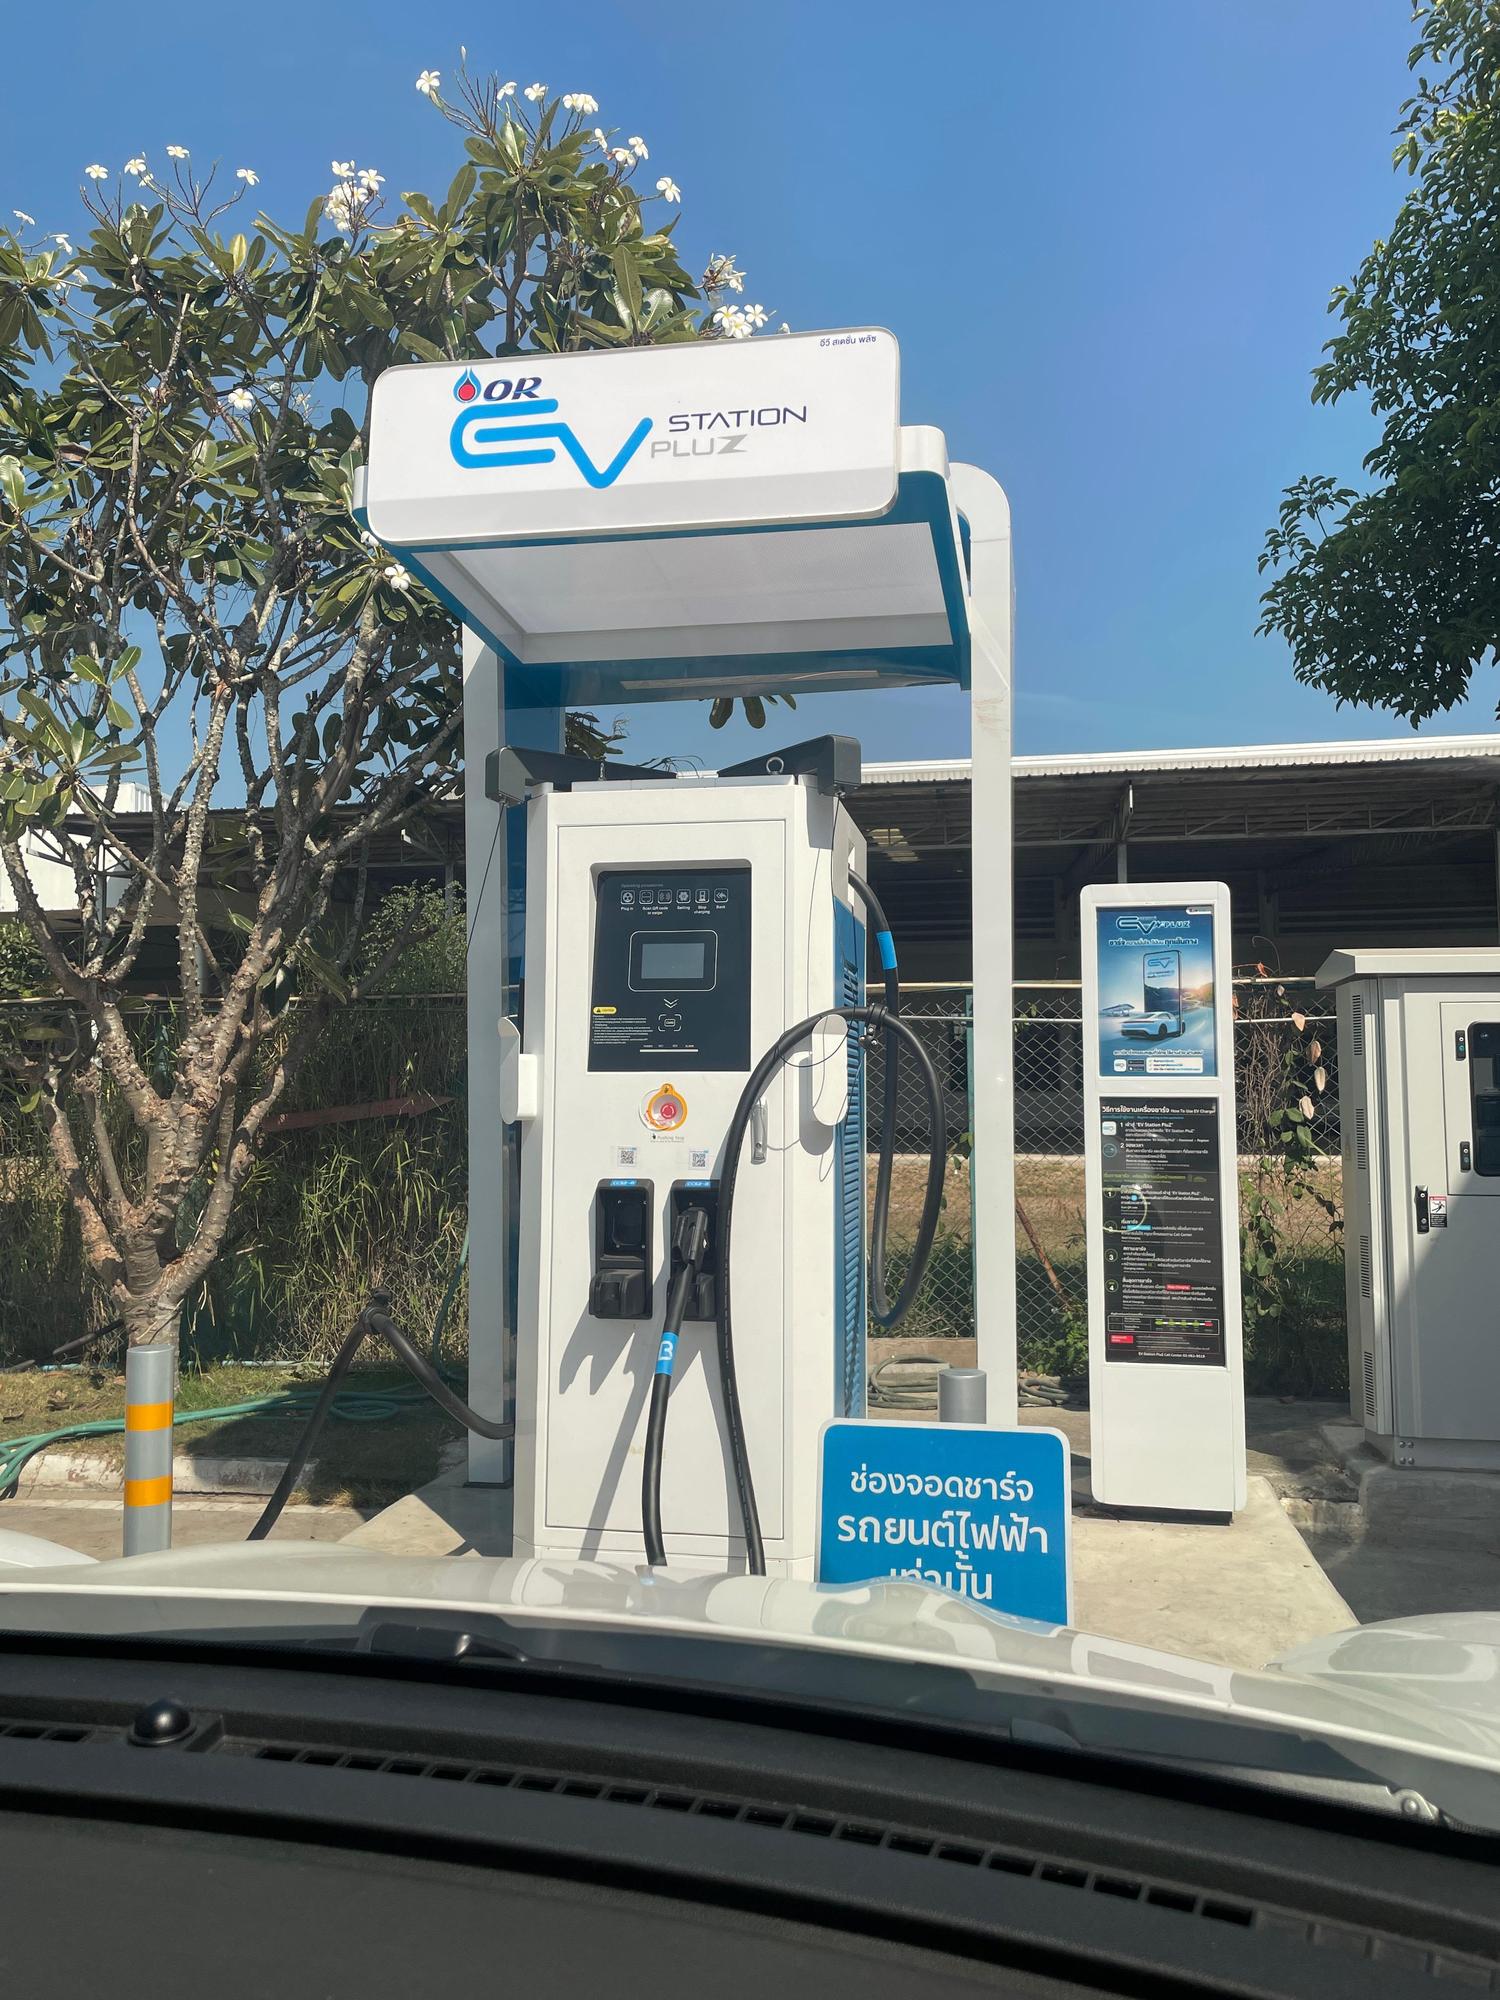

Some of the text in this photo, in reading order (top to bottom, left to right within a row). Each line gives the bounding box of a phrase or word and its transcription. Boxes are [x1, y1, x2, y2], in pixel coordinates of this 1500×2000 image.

[484, 376, 542, 400] OR
[668, 405, 807, 433] STATION
[450, 398, 653, 489] EV
[651, 433, 748, 459] PLUZ
[658, 1340, 674, 1360] B
[850, 1463, 1034, 1501] ช่องจอดชาร์จ
[837, 1510, 1049, 1553] รถยนต์ไฟฟ้า
